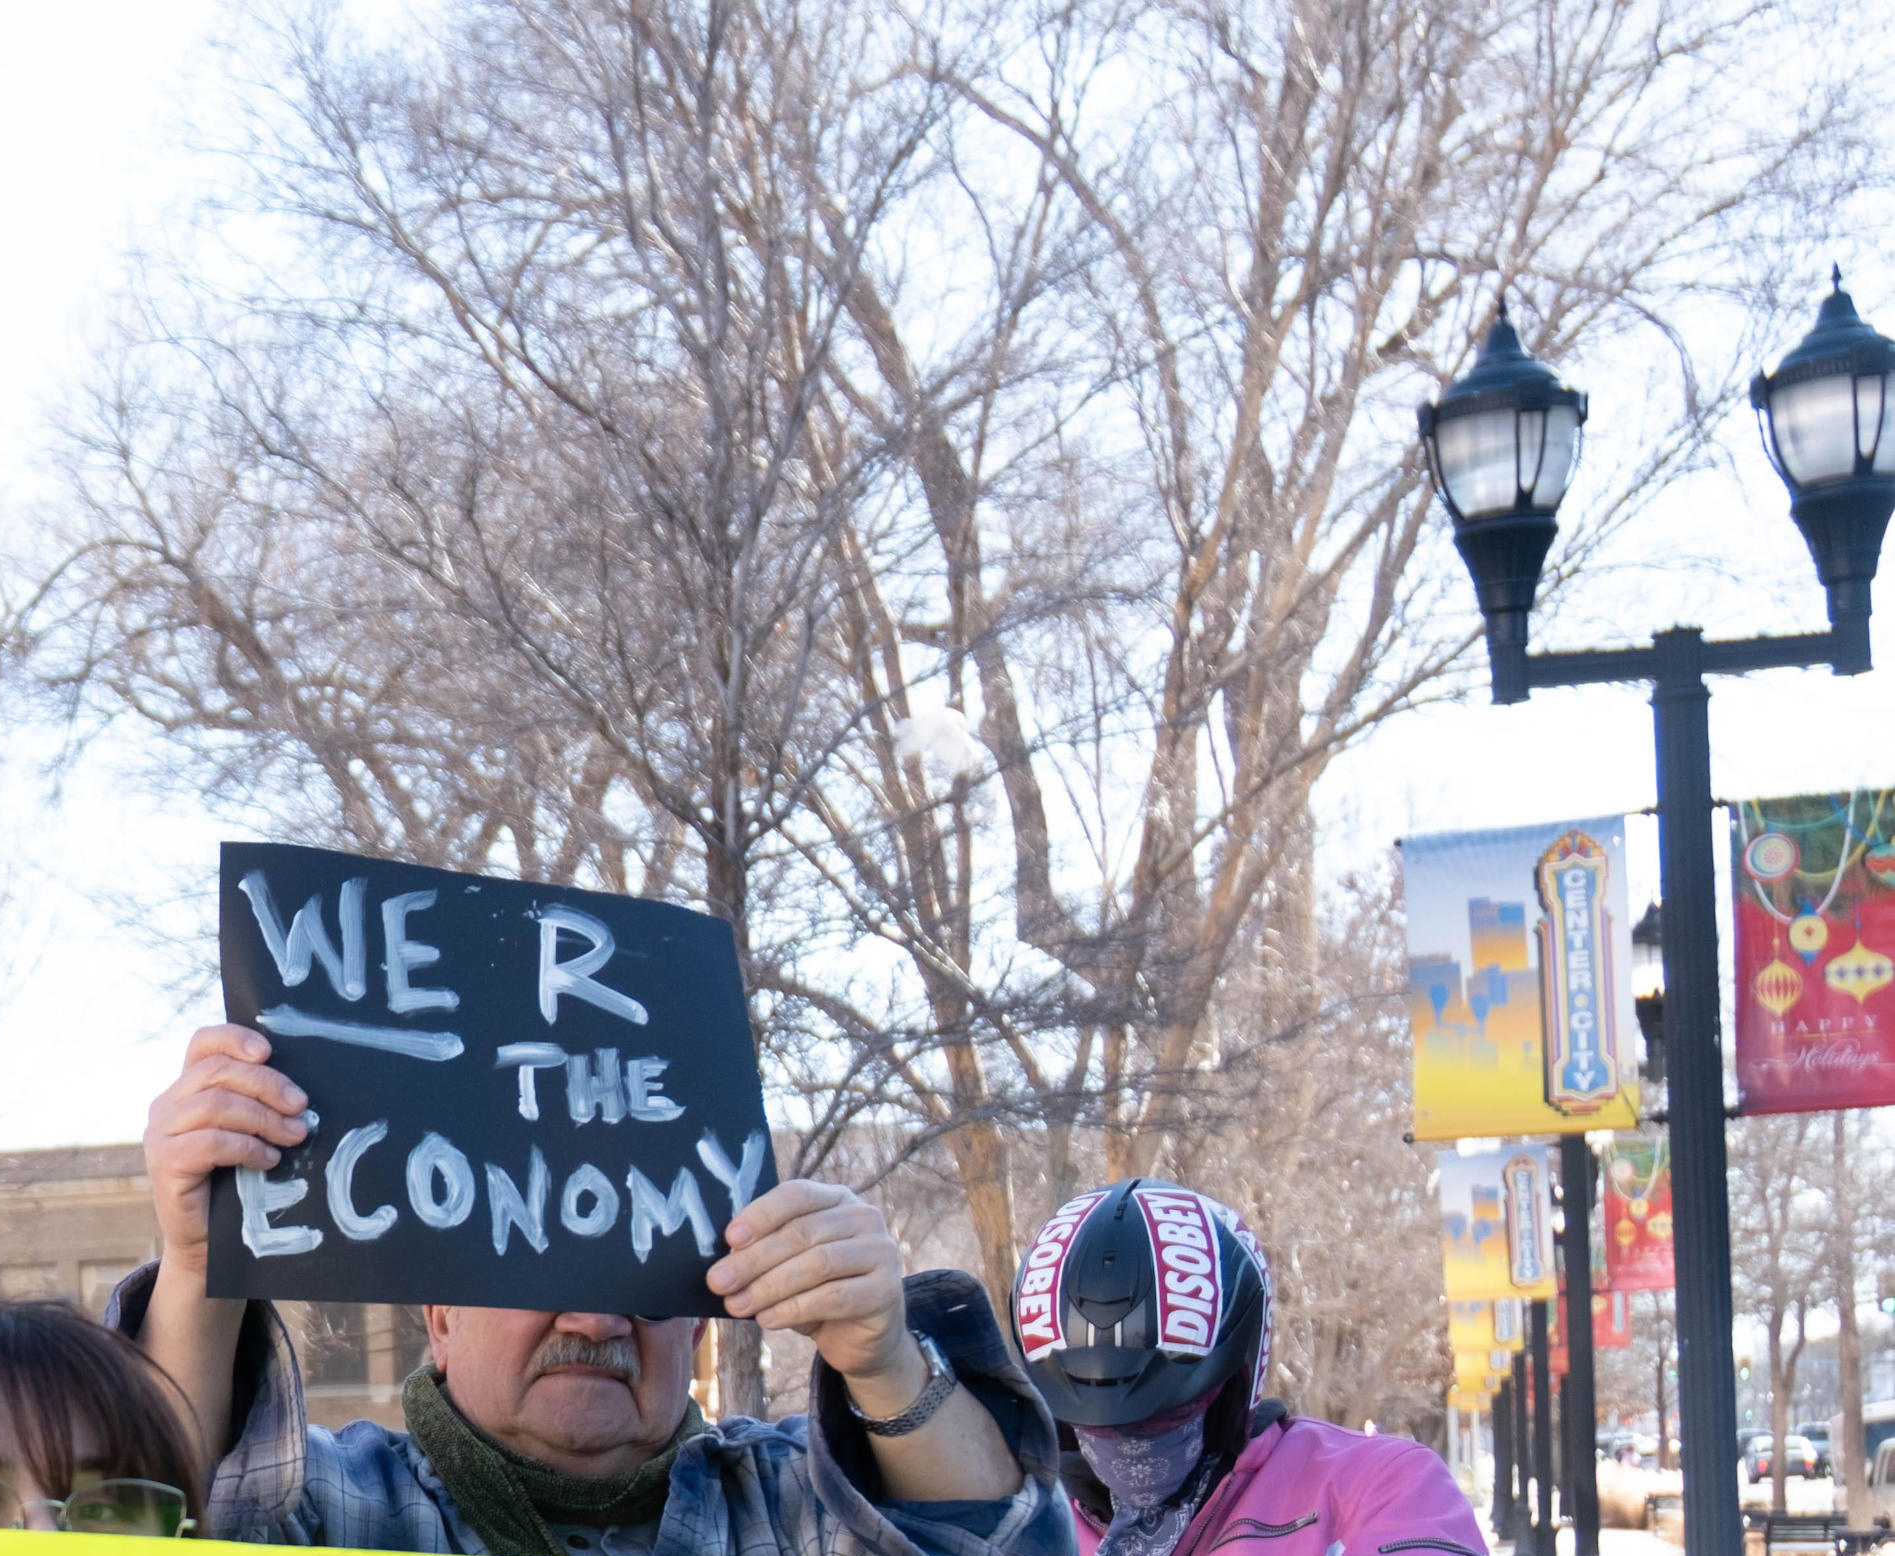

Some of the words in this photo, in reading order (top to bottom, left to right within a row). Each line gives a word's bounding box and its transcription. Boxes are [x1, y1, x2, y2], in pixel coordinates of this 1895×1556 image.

[238, 869, 461, 1014] WE
[536, 902, 649, 1026] R
[1563, 868, 1592, 990] CENTER
[495, 1041, 687, 1123] THE
[1571, 1011, 1595, 1092] CITY
[1770, 1015, 1878, 1034] HAPPY
[236, 1116, 766, 1264] ECONOMY
[1020, 1197, 1097, 1341] DISOBEY
[1142, 1193, 1216, 1346] DISOBEY
